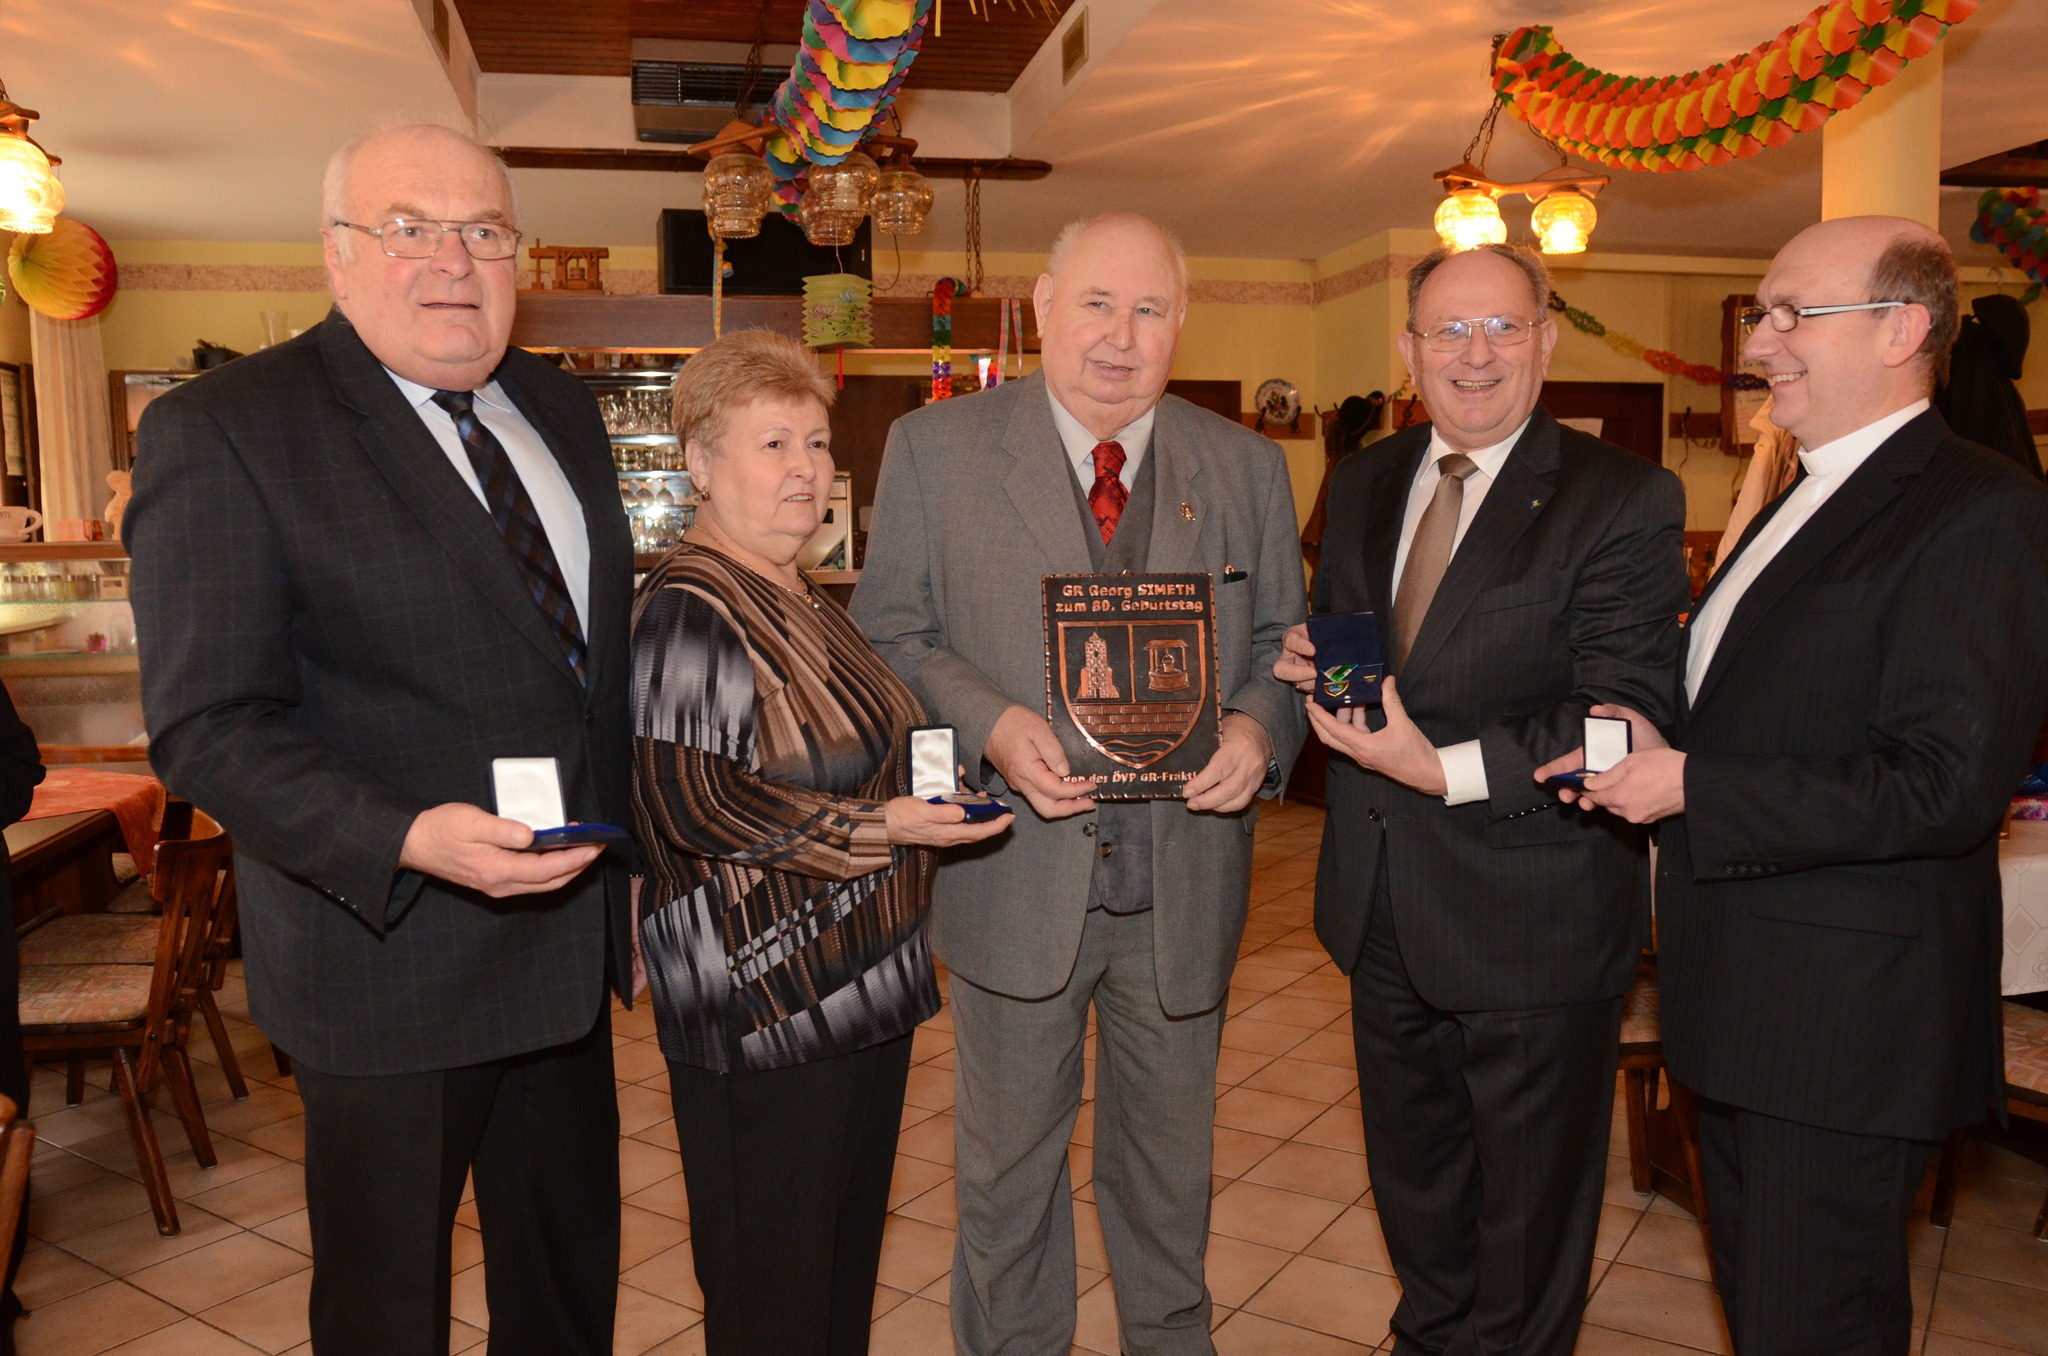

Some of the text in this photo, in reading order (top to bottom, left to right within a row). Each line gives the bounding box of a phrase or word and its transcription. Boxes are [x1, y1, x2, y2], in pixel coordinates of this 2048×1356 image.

[1062, 583, 1196, 598] GR Georg SIMETH
[1055, 600, 1204, 613] zum 80. Geburtstag
[1088, 773, 1109, 784] der
[1112, 771, 1137, 783] ÖVP
[1140, 770, 1197, 782] GR-Frakti
